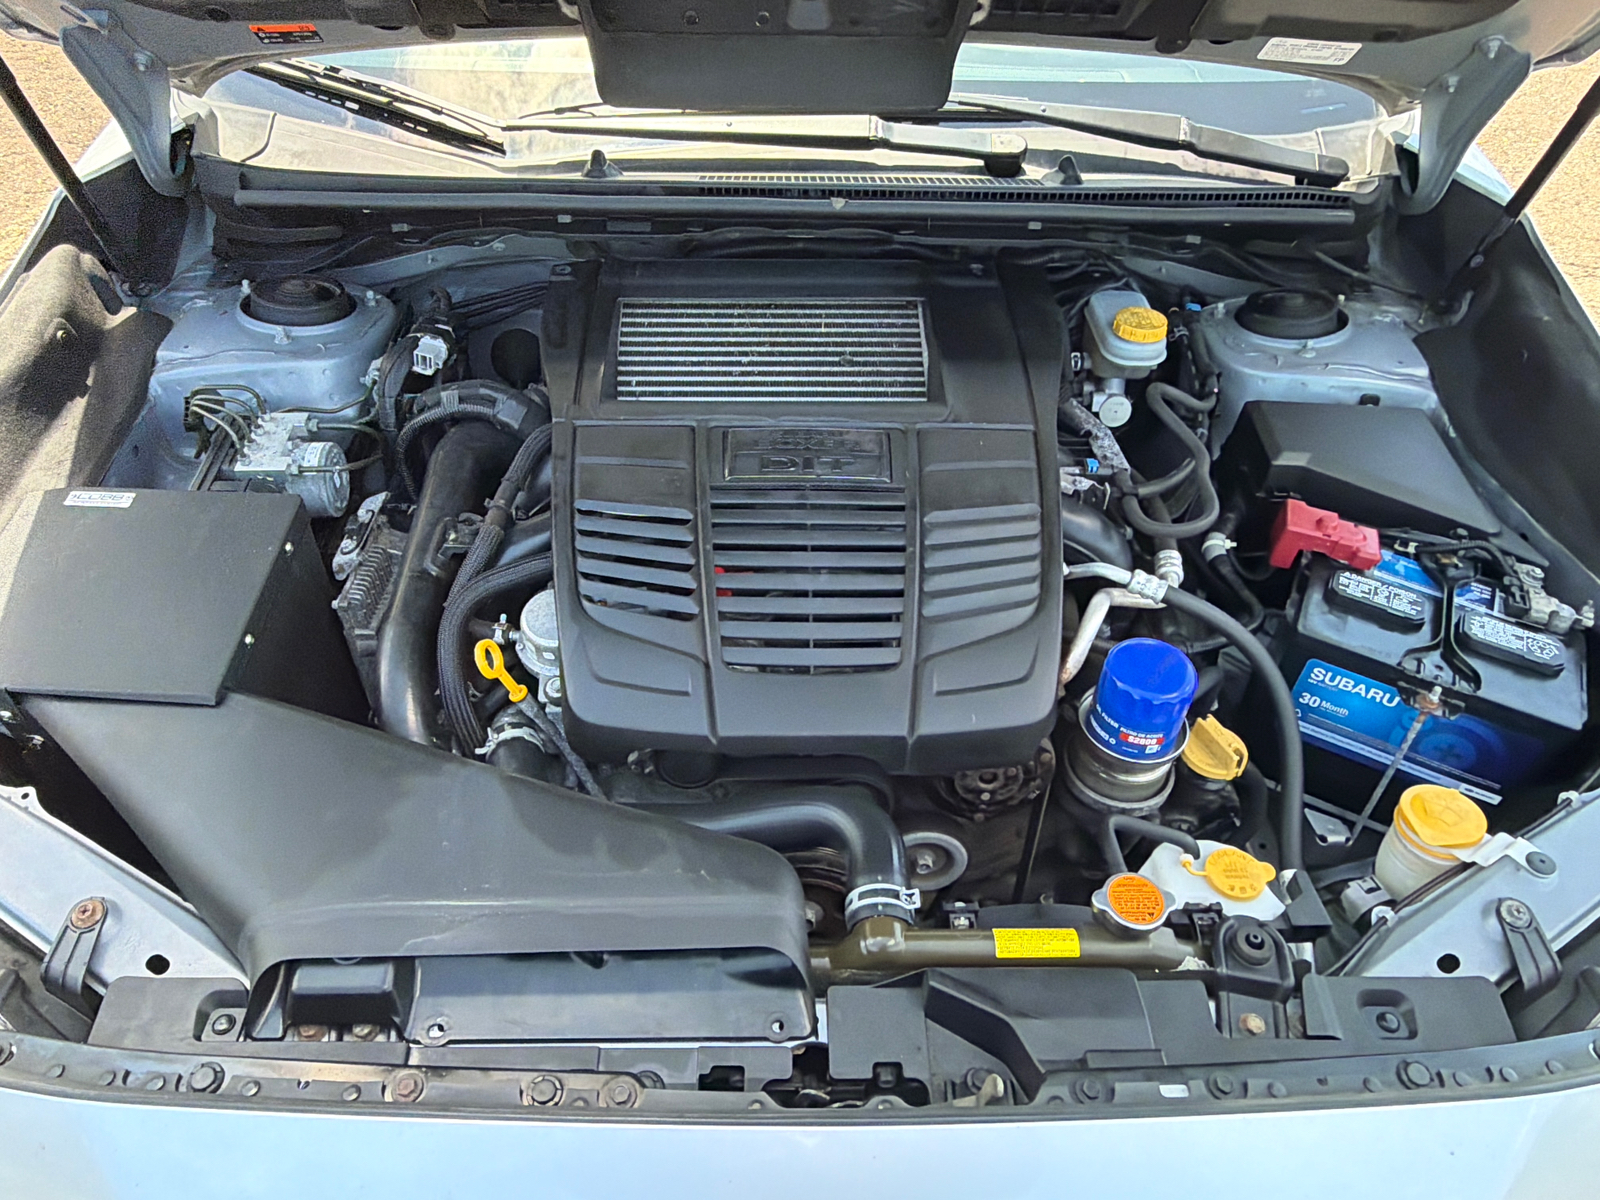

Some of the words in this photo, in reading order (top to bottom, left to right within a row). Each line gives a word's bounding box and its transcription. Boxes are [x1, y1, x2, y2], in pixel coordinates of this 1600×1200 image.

[760, 455, 857, 472] DIT
[77, 493, 125, 501] COBB
[1310, 667, 1401, 707] SUBARU
[1299, 692, 1321, 708] 30
[1320, 700, 1349, 717] Month
